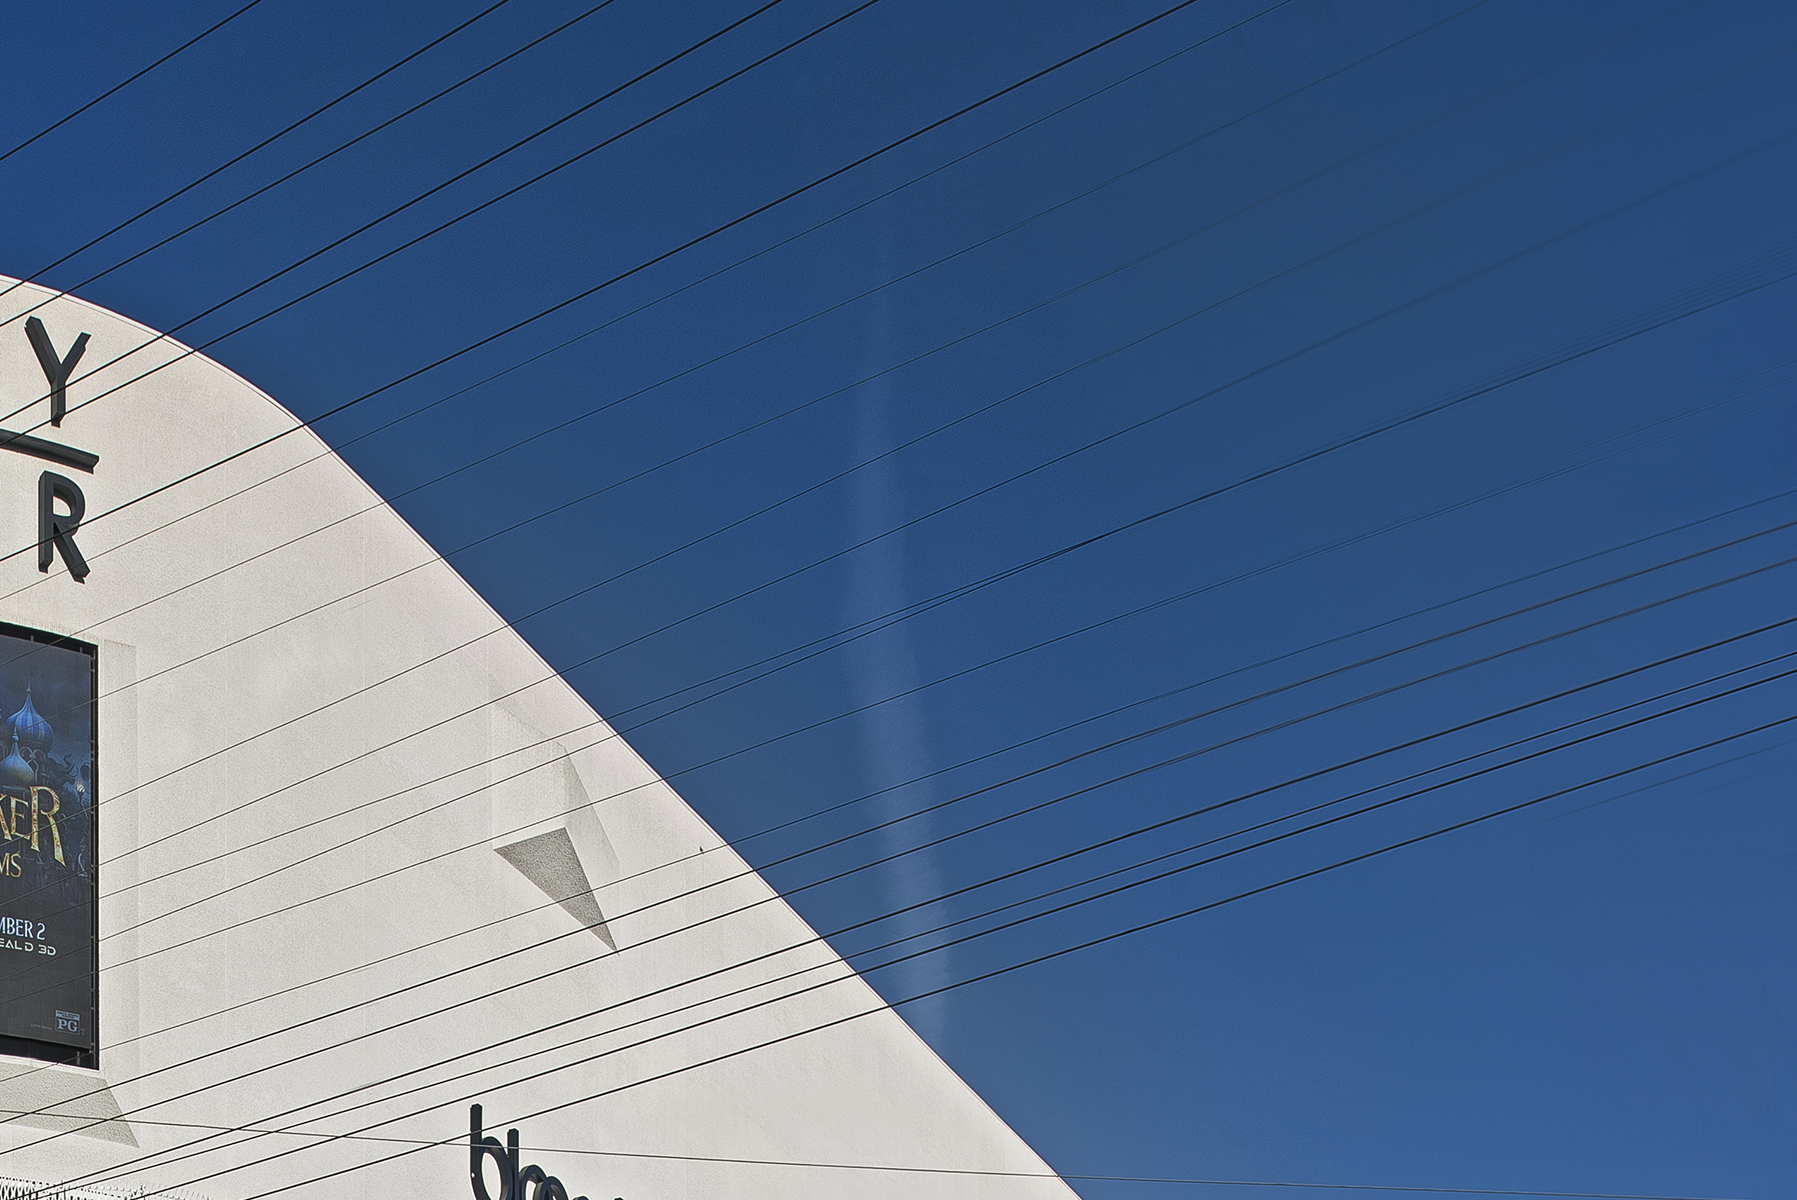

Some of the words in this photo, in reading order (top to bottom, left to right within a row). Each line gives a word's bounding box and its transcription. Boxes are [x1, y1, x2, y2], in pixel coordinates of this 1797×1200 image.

[36, 922, 46, 940] 2
[38, 944, 57, 956] 3D
[57, 1018, 78, 1032] PG
